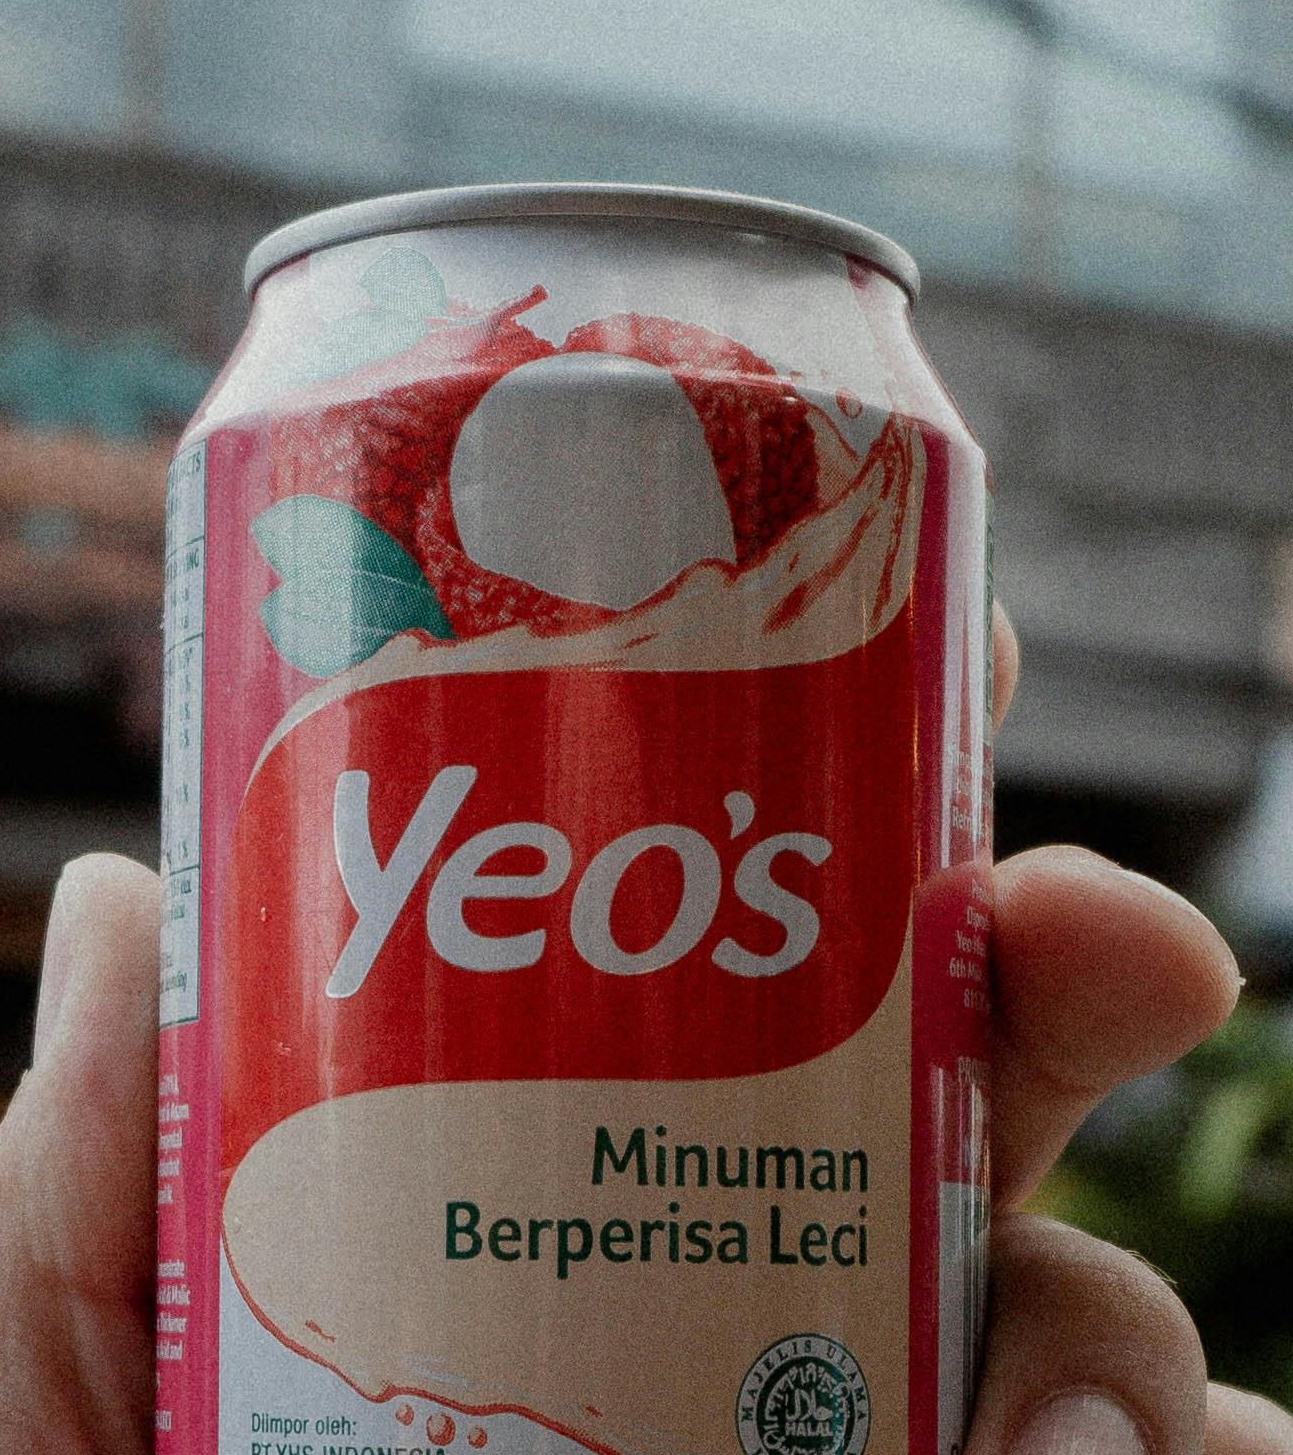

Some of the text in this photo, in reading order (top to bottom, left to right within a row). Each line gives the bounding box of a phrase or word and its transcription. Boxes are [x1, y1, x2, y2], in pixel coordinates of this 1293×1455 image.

[325, 764, 833, 999] Yeo's
[591, 1124, 869, 1193] Minuman
[444, 1200, 868, 1281] Berperisa Leci
[741, 1339, 867, 1422] MAJELIS ULAMA
[250, 1412, 358, 1439] Diimpor oleh:
[785, 1421, 834, 1437] HALAL
